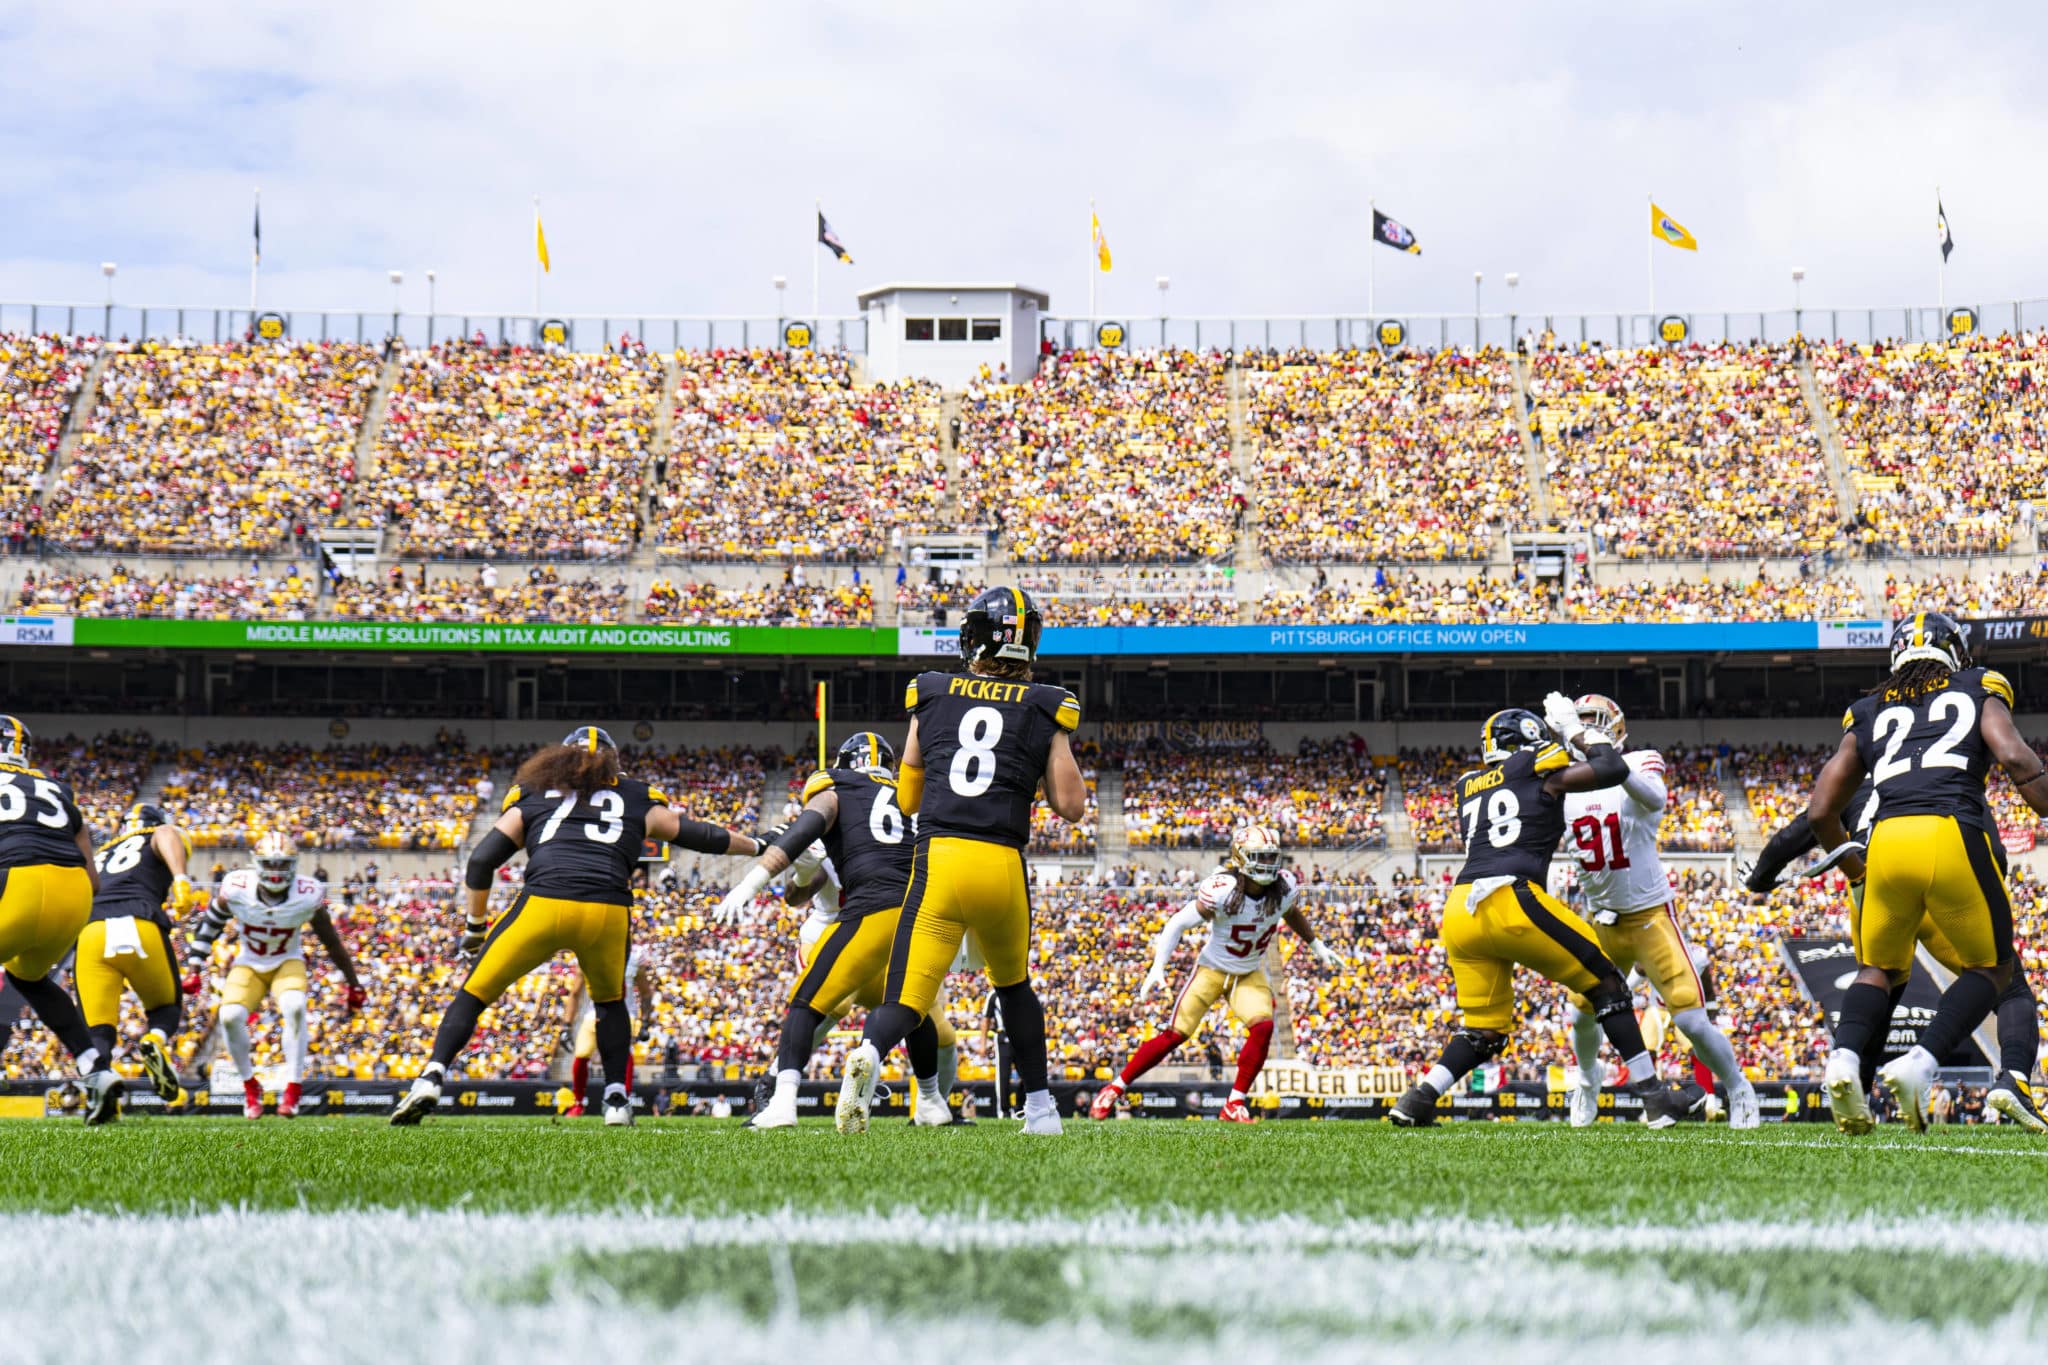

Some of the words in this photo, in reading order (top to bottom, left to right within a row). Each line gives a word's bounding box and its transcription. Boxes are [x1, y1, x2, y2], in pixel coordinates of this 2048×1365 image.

[17, 628, 53, 641] RSM
[246, 626, 309, 641] MIDDLE
[313, 627, 384, 642] MARKET
[386, 627, 480, 643] SOLUTIONS
[483, 628, 500, 643] IN
[504, 628, 536, 643] TAX
[538, 628, 586, 644] AUDIT
[590, 629, 627, 645] AND
[628, 630, 731, 646] CONSULTING
[1271, 630, 1372, 645] PITTSBURGH
[1376, 630, 1432, 645] OFFICE
[1437, 630, 1477, 645] NOW
[1481, 629, 1526, 644] OPEN
[1847, 632, 1884, 645] RSM
[1984, 622, 2025, 640] TEXT
[949, 677, 1030, 703] PICKETT
[949, 706, 1004, 797] 8
[1873, 691, 1976, 788] 22
[1464, 765, 1504, 798] DANIELS
[538, 789, 625, 844] 73
[1462, 789, 1522, 859] 78
[1573, 811, 1631, 871] 91
[243, 922, 295, 957] 57
